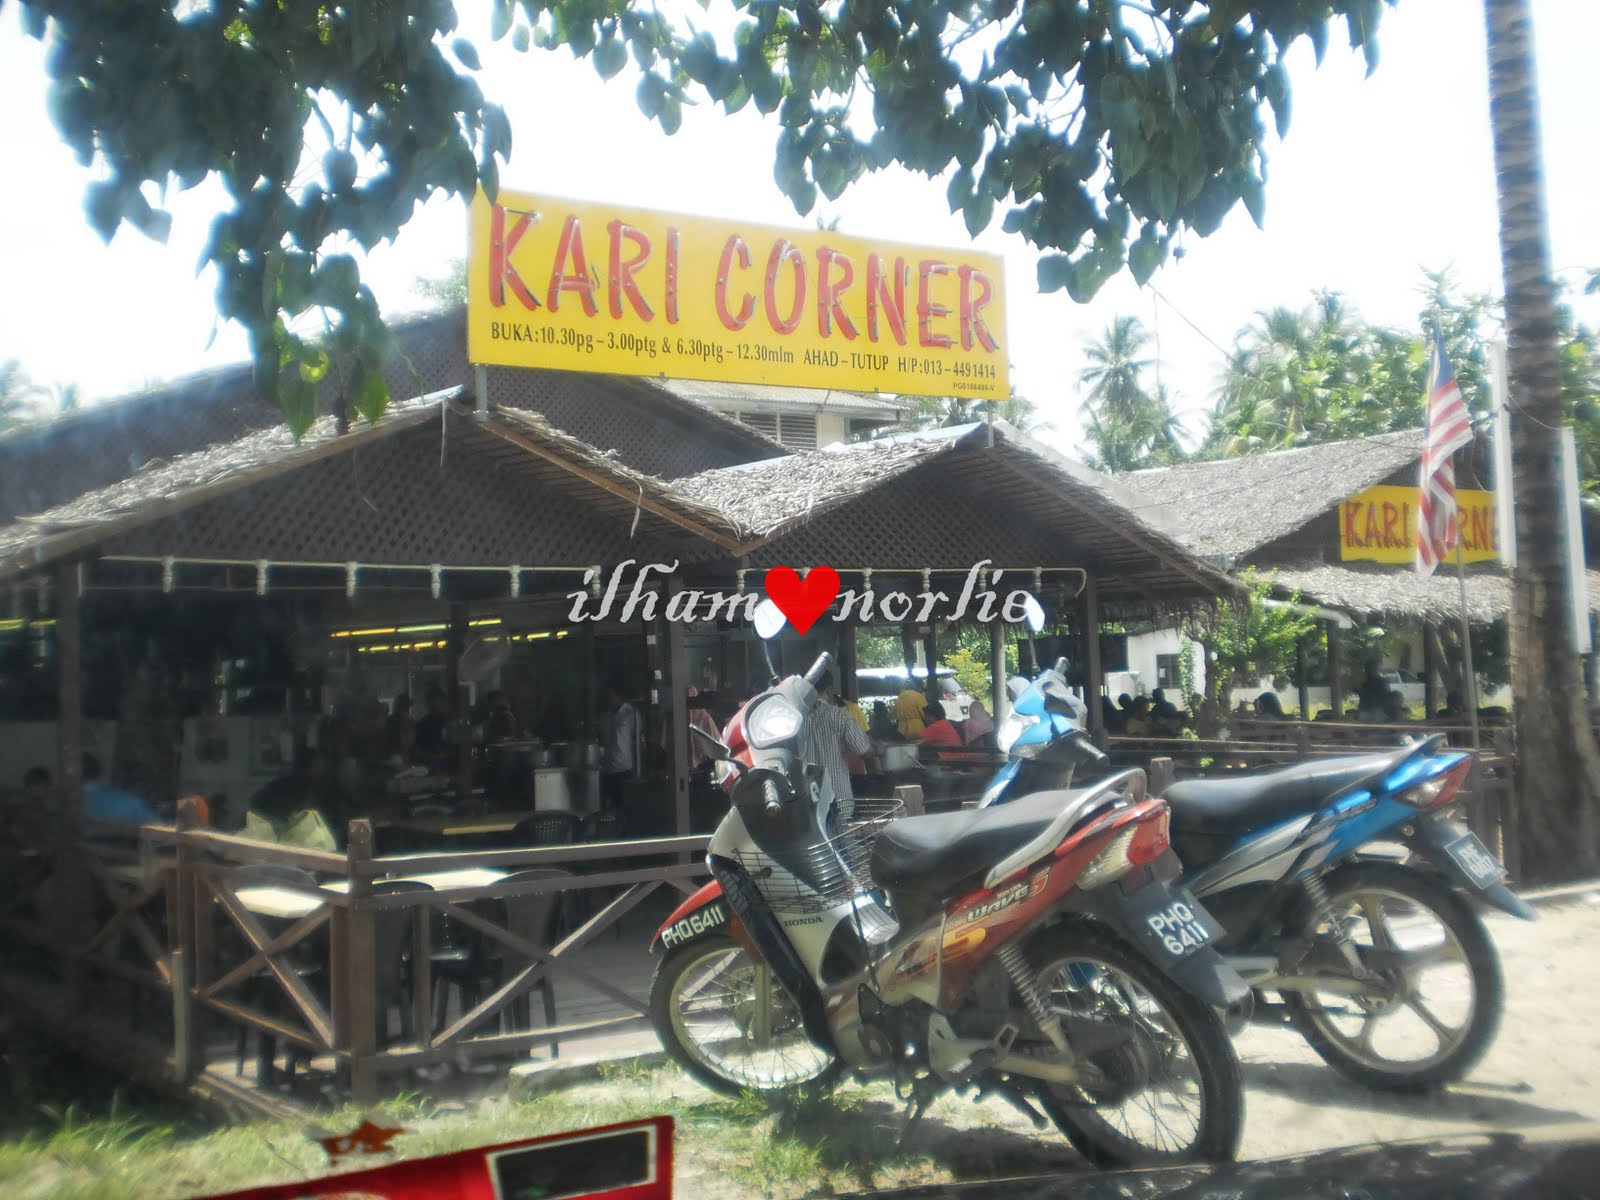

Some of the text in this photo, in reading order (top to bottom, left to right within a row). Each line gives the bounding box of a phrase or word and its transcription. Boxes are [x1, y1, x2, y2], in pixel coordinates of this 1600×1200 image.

[489, 203, 999, 353] KARI CORNER
[662, 336, 672, 354] &
[804, 348, 839, 367] AHAD
[850, 352, 889, 371] TUTUP
[1345, 501, 1410, 549] KARI
[784, 916, 824, 928] HONDA
[1148, 903, 1195, 938] PHQ
[1164, 920, 1209, 955] 6411
